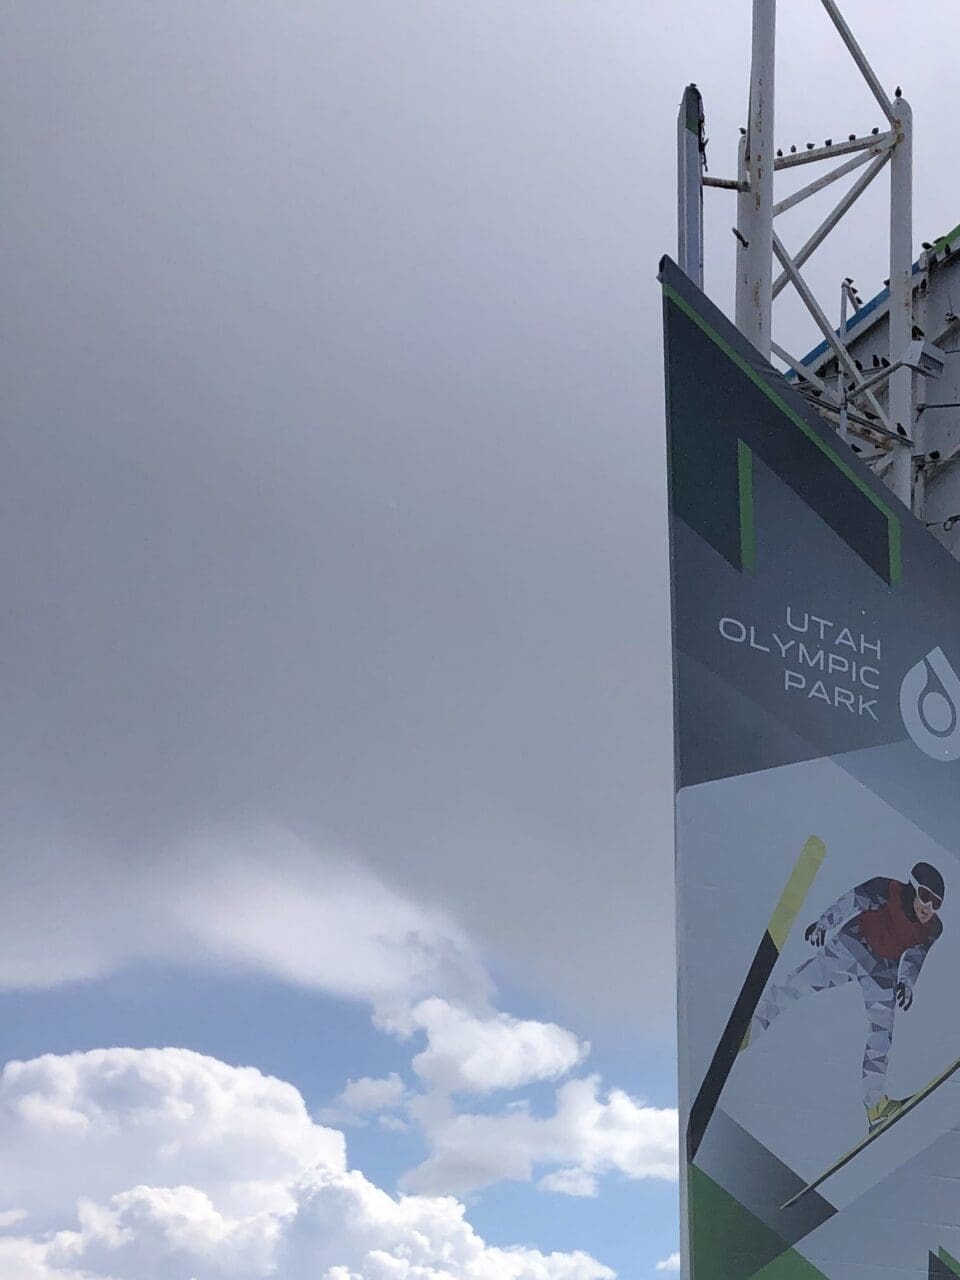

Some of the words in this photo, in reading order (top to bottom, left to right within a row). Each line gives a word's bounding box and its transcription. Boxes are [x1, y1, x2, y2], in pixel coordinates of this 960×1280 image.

[718, 617, 880, 690] OLYMPIC
[786, 606, 881, 660] UTAH
[784, 669, 879, 721] PARK
